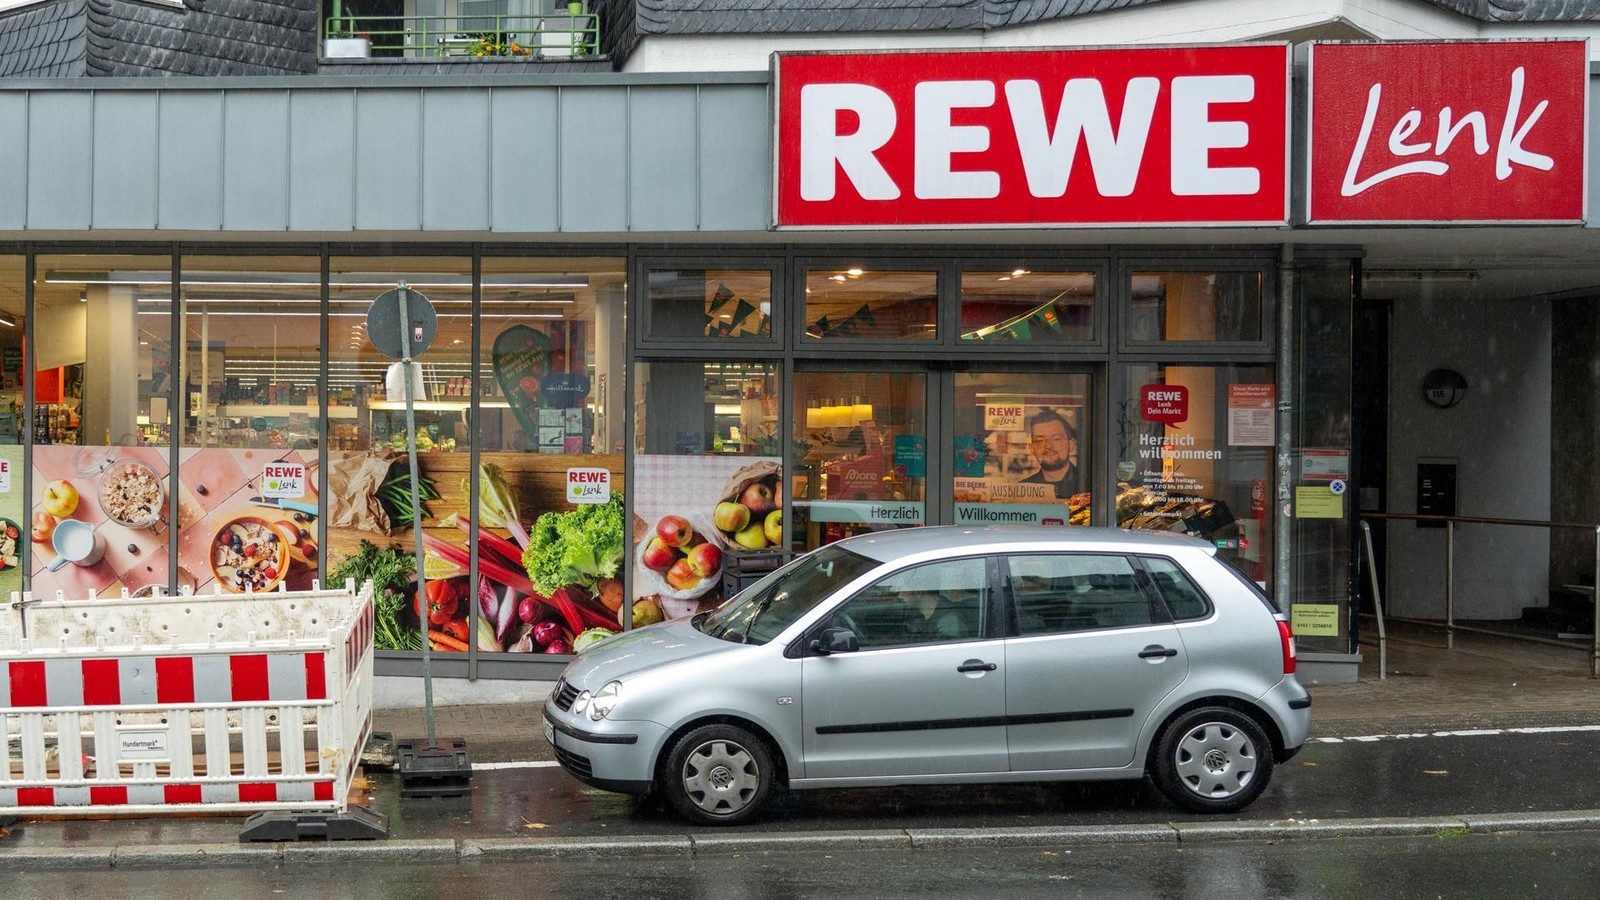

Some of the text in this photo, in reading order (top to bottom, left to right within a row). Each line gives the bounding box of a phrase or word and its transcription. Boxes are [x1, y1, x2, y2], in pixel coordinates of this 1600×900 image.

[800, 75, 1261, 201] REWE
[1340, 66, 1554, 198] Lenk
[546, 385, 585, 395] Hallmark
[1148, 391, 1182, 401] REWE
[988, 407, 1021, 416] REWE
[1162, 407, 1181, 415] Markt
[1139, 434, 1195, 446] Herzlich
[1139, 446, 1222, 459] willkommen
[265, 466, 302, 478] REWE
[569, 471, 607, 483] REWE
[845, 468, 877, 480] More
[278, 478, 297, 490] Lenk
[582, 484, 602, 496] Lenk
[992, 485, 1045, 498] AUSBILDUNG
[870, 506, 919, 519] Herzlich
[959, 507, 1037, 521] Willkommen
